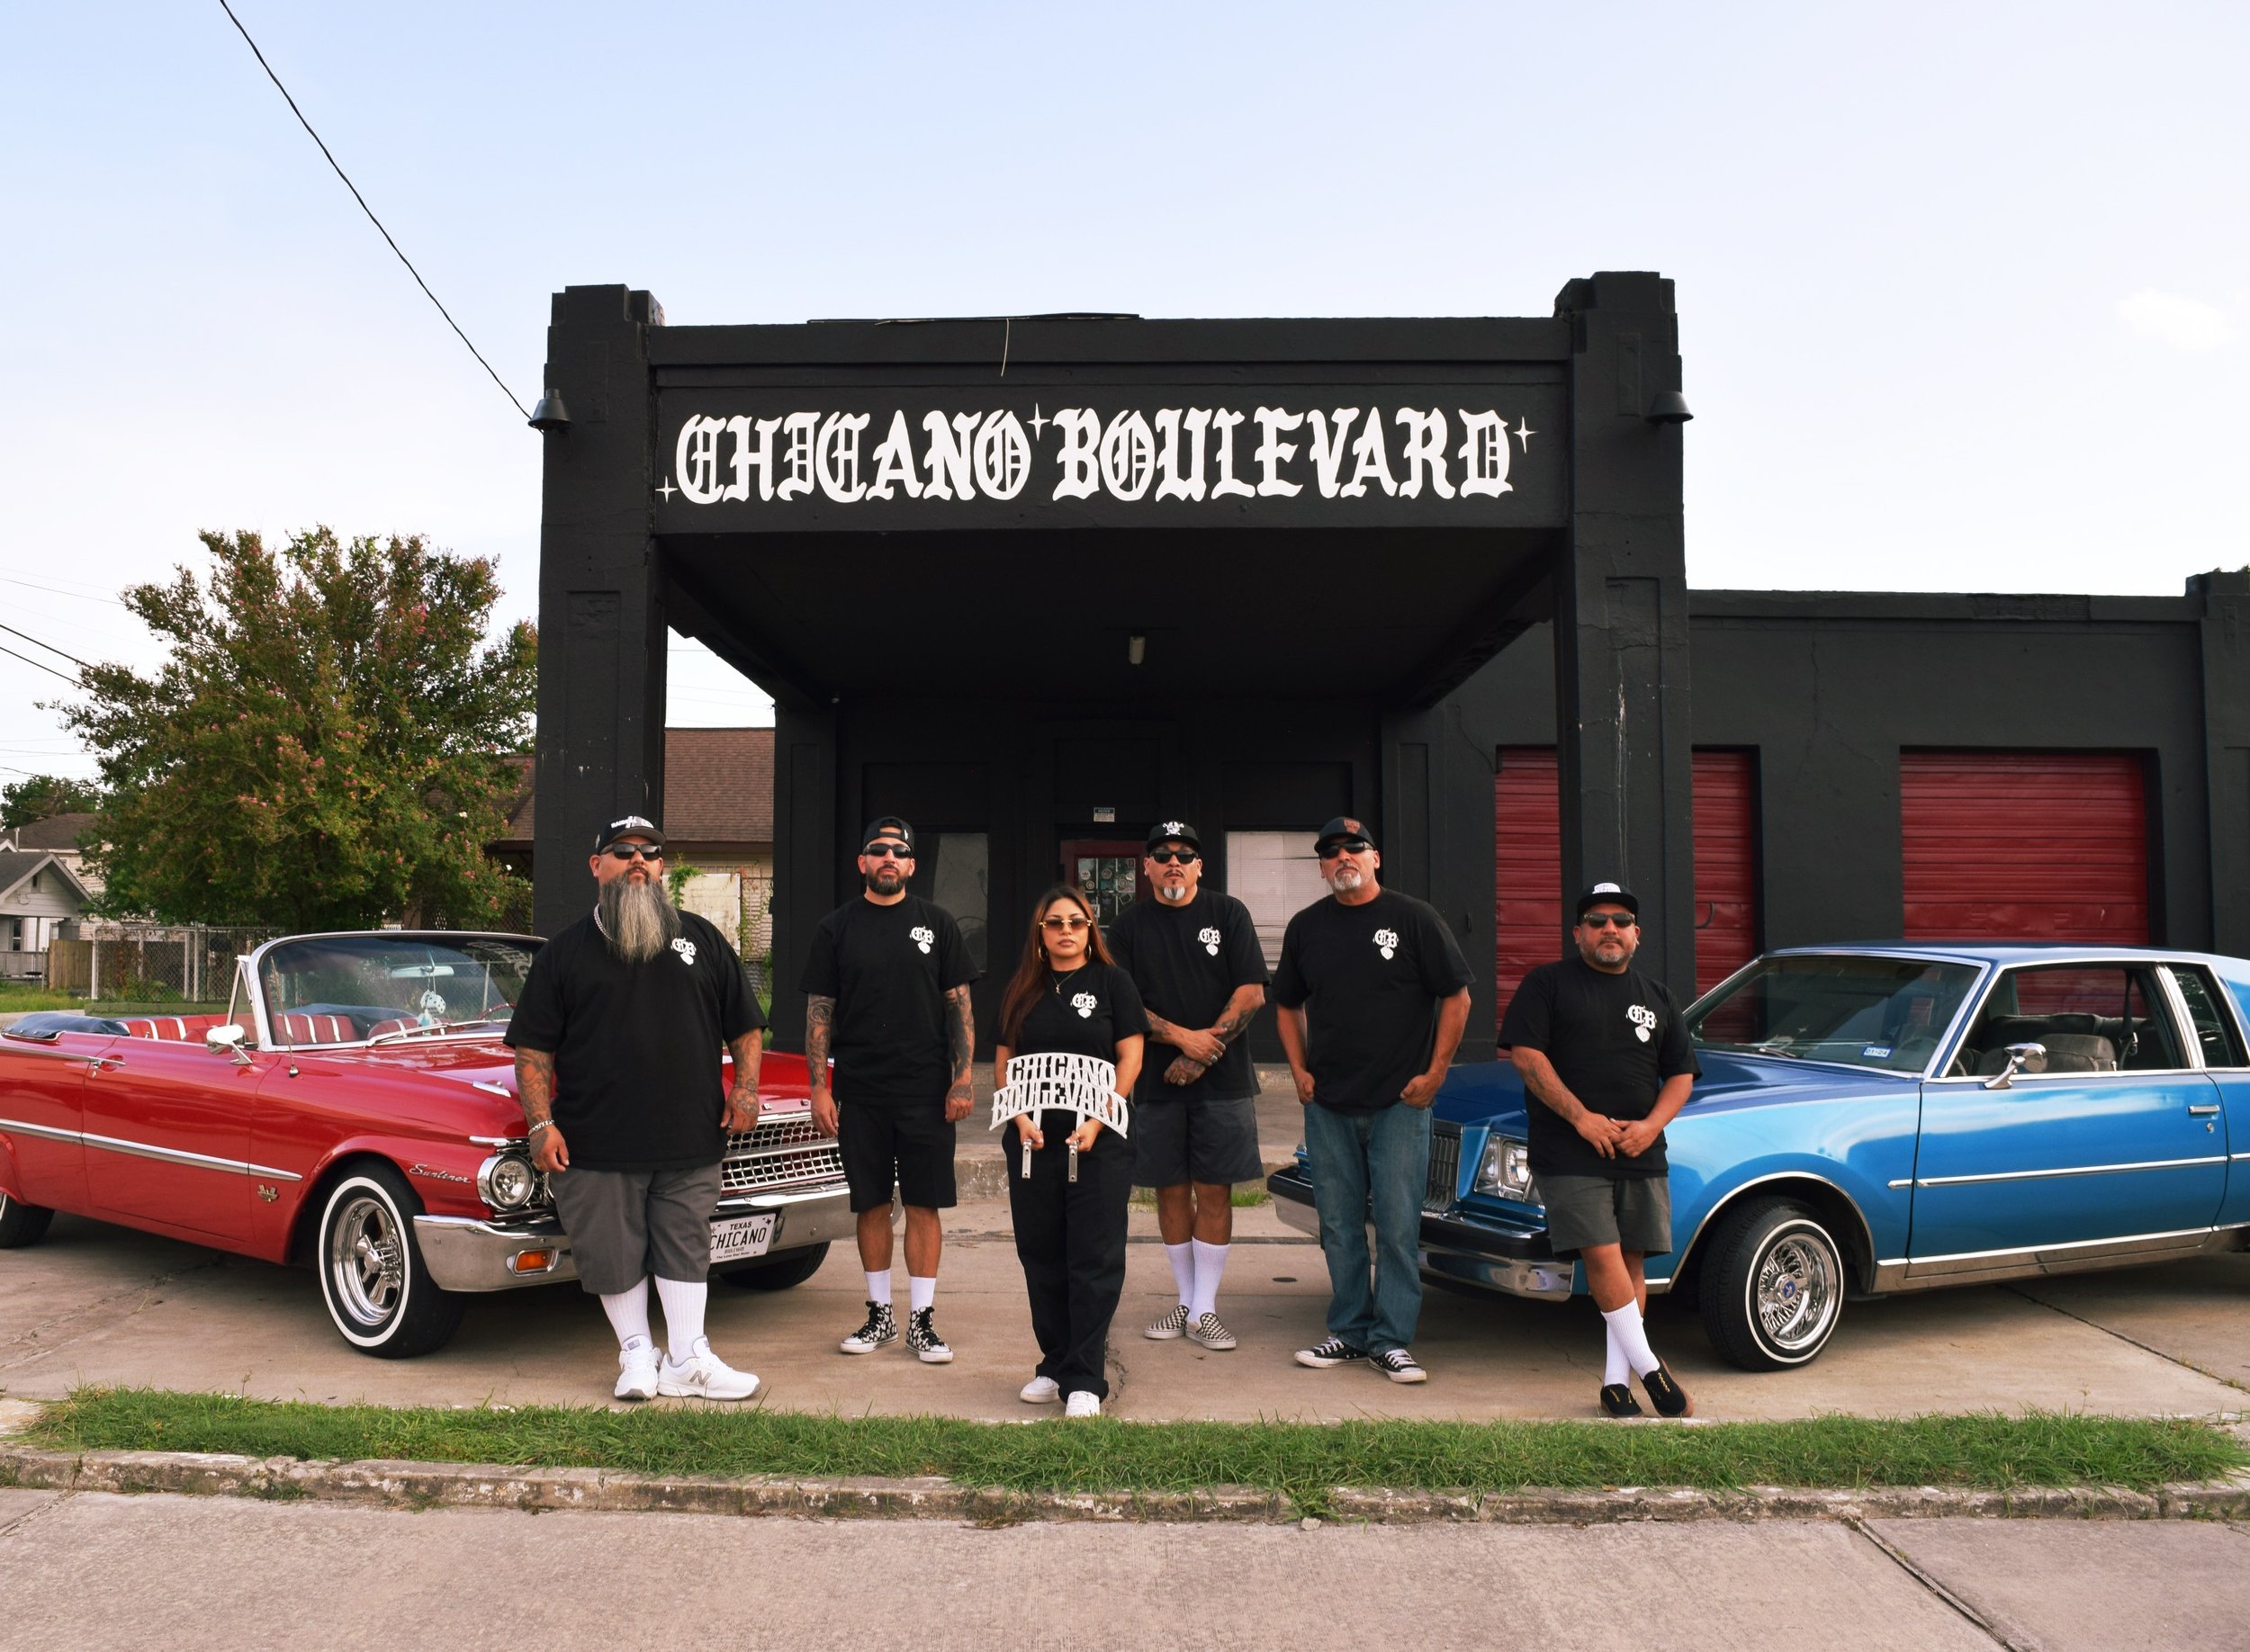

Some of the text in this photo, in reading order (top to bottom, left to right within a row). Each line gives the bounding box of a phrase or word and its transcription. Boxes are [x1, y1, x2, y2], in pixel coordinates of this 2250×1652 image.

[676, 406, 1514, 505] CHICANO BOULEVARD
[1005, 1054, 1117, 1091] CHICANO
[989, 1081, 1129, 1139] BOULEVARD
[730, 1221, 752, 1230] TEXAS
